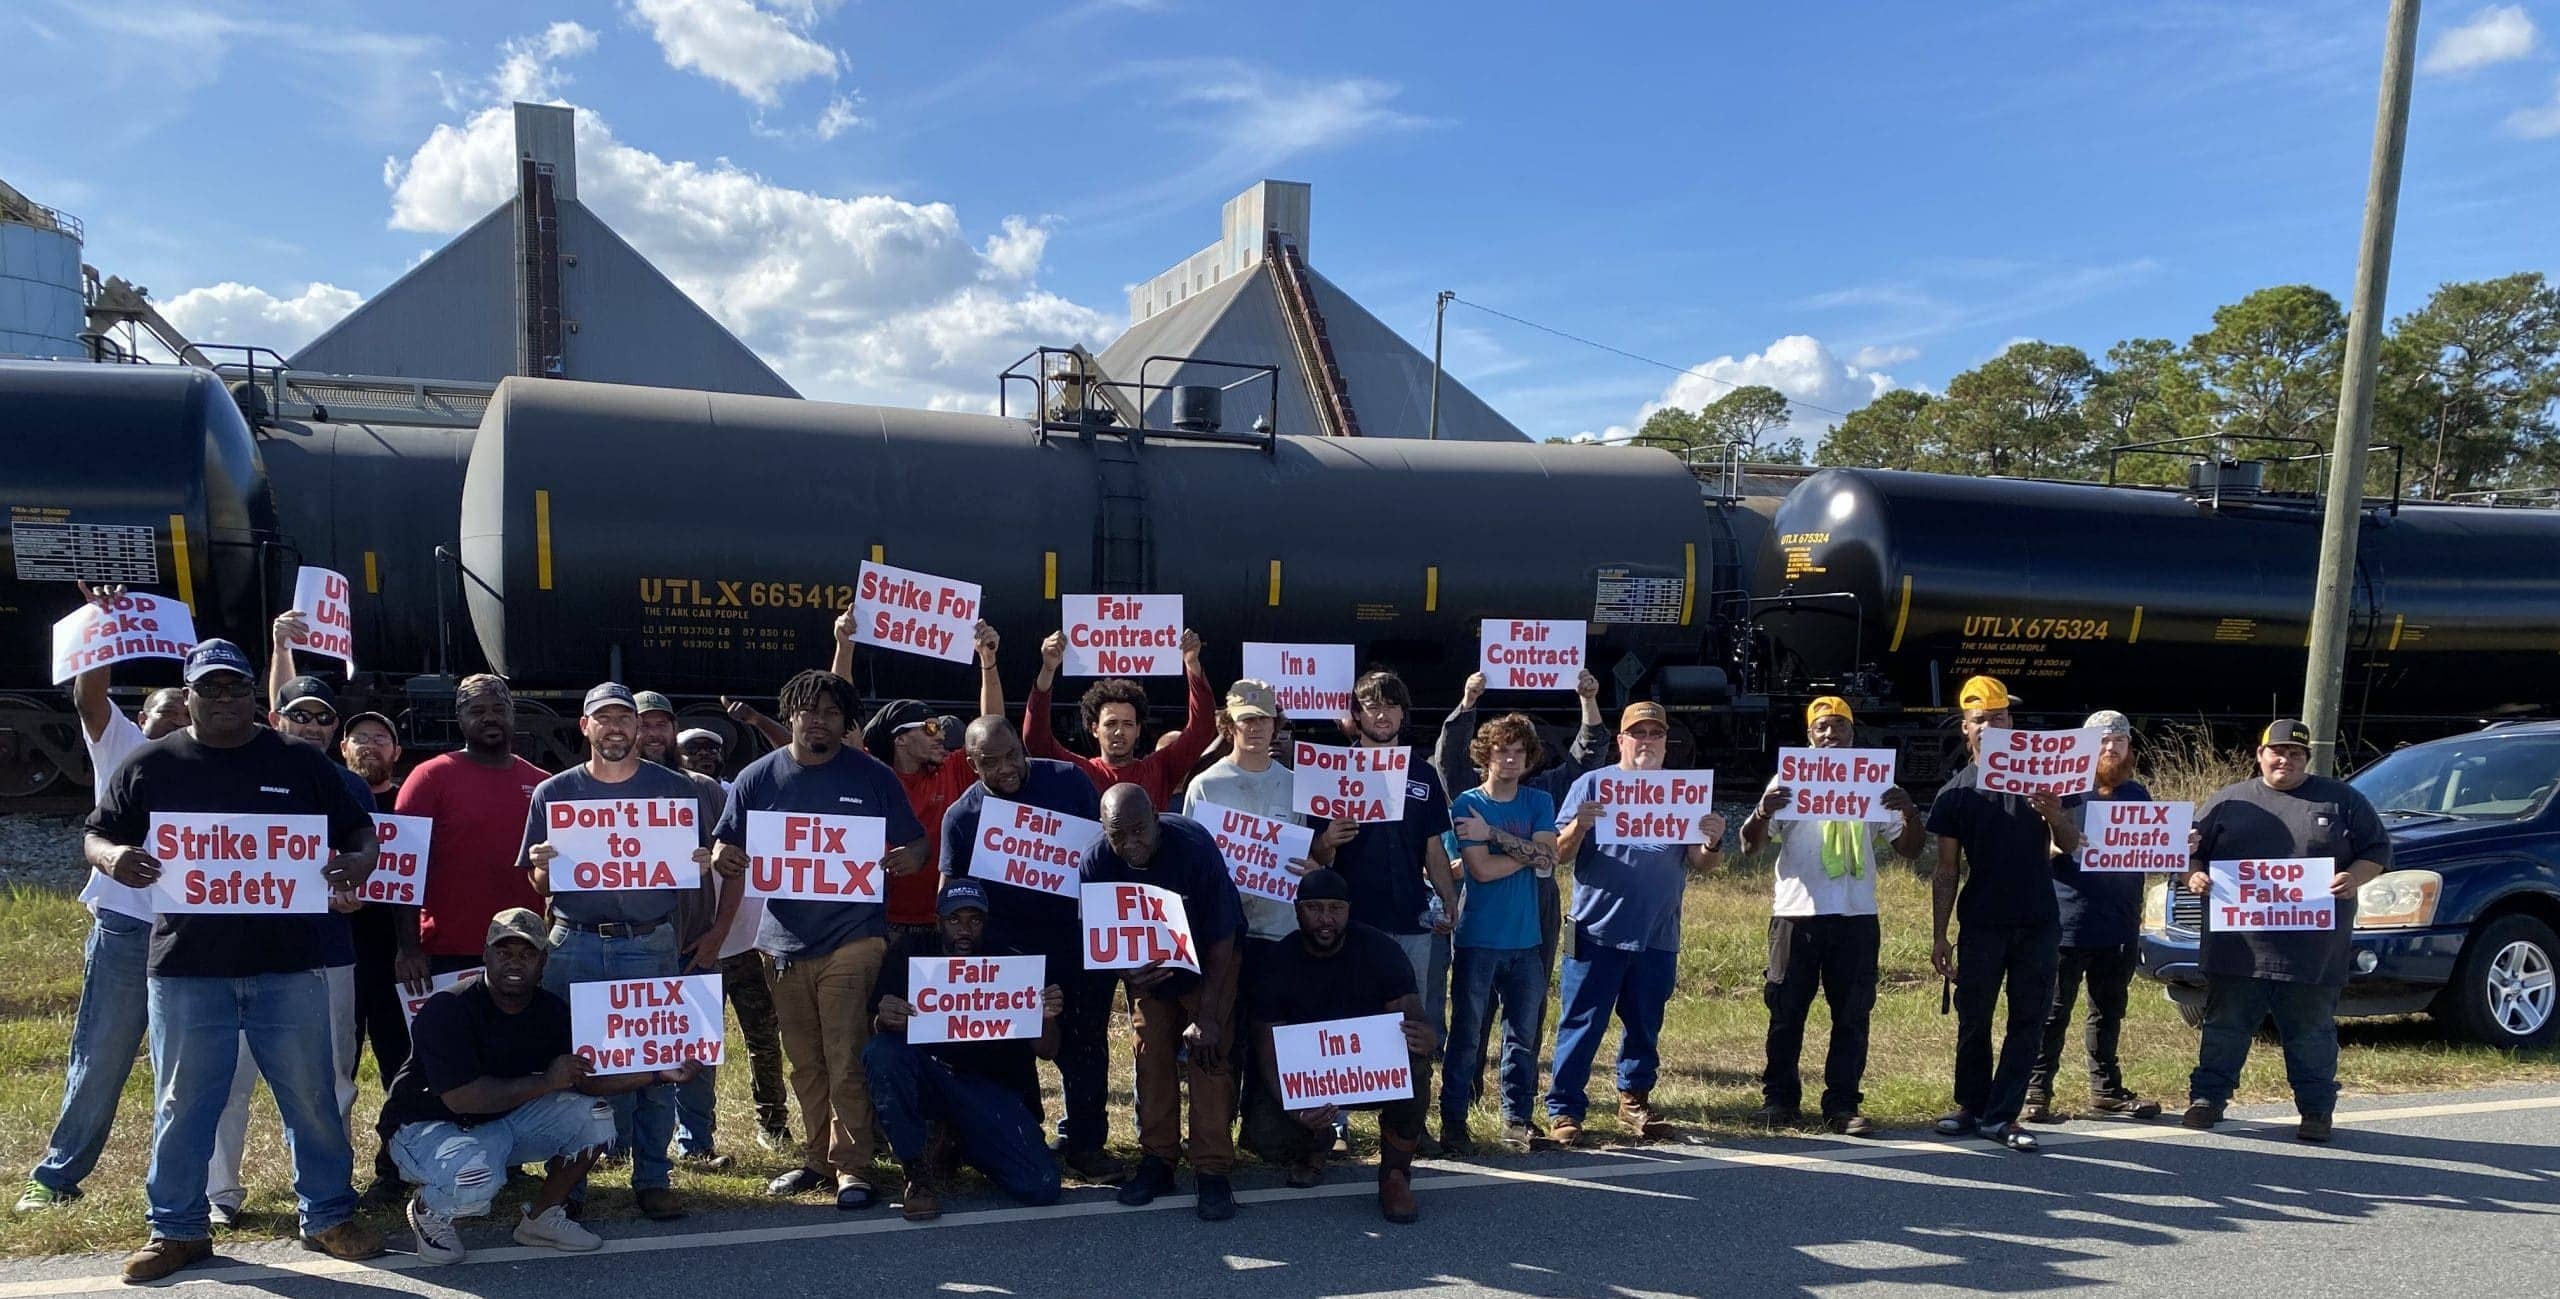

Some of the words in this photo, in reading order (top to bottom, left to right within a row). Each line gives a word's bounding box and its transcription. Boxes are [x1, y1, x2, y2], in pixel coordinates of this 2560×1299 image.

[101, 595, 157, 615] top
[640, 578, 744, 607] UTLX
[750, 582, 853, 610] 665412
[861, 571, 932, 614] Strike
[937, 588, 976, 620] For
[644, 606, 662, 616] THE
[666, 608, 689, 617] TANK
[692, 609, 712, 618] CAR
[715, 610, 750, 620] PEOPLE
[1097, 596, 1143, 620] Fair
[82, 613, 159, 645] Fake
[874, 611, 954, 655] Safety
[1070, 624, 1177, 648] Contract
[1511, 621, 1549, 642] Fair
[1963, 616, 2024, 638] UTLX
[2026, 618, 2109, 641] 675324
[1487, 644, 1579, 666] Contract
[1961, 641, 1977, 650] THE
[1978, 642, 1998, 651] TANK
[2016, 643, 2048, 653] PEOPLE
[1098, 650, 1154, 674] Now
[1281, 650, 1303, 676] I'm
[1307, 657, 1315, 675] a
[1509, 669, 1559, 689] Now
[1277, 686, 1351, 710] stleblower
[2010, 732, 2076, 755] Stop
[1297, 743, 1366, 772] Don't
[1372, 749, 1406, 772] Lie
[1782, 756, 1848, 783] Strike
[1853, 757, 1890, 783] For
[1988, 751, 2091, 776] Cutting
[1338, 777, 1364, 797] to
[1600, 779, 1665, 805] Strike
[1671, 779, 1708, 804] For
[1984, 772, 2087, 796] Corners
[550, 802, 639, 830] Don't
[647, 801, 694, 828] Lie
[1311, 795, 1386, 821] OSHA
[1797, 788, 1871, 818] Safety
[2111, 805, 2169, 825] UTLX
[1016, 805, 1062, 836] Fair
[1222, 810, 1283, 845] UTLX
[1615, 811, 1689, 839] Safety
[156, 823, 257, 861] Strike
[267, 826, 321, 860] For
[608, 832, 641, 858] to
[785, 816, 847, 855] Fix
[984, 827, 1080, 867] Contrac
[2104, 827, 2170, 846] Unsafe
[2084, 848, 2186, 870] Conditions
[2237, 860, 2304, 882] Stop
[574, 861, 677, 889] OSHA
[752, 856, 876, 896] UTLX
[1005, 859, 1064, 891] Now
[1235, 864, 1298, 901] Safety
[185, 870, 296, 908] Safety
[2240, 884, 2303, 903] Fake
[1116, 886, 1168, 922] Fix
[2222, 907, 2331, 929] Training
[1088, 926, 1197, 967] UTLX
[948, 958, 1000, 983] Fair
[610, 981, 684, 1009] UTLX
[917, 988, 1036, 1012] Contract
[607, 1010, 689, 1039] Profits
[947, 1015, 1010, 1039] Now
[576, 1044, 634, 1069] Over
[643, 1037, 721, 1065] Safety
[1319, 1030, 1344, 1057] I'm
[1351, 1035, 1360, 1052] a
[1283, 1066, 1409, 1099] Whistleblower
